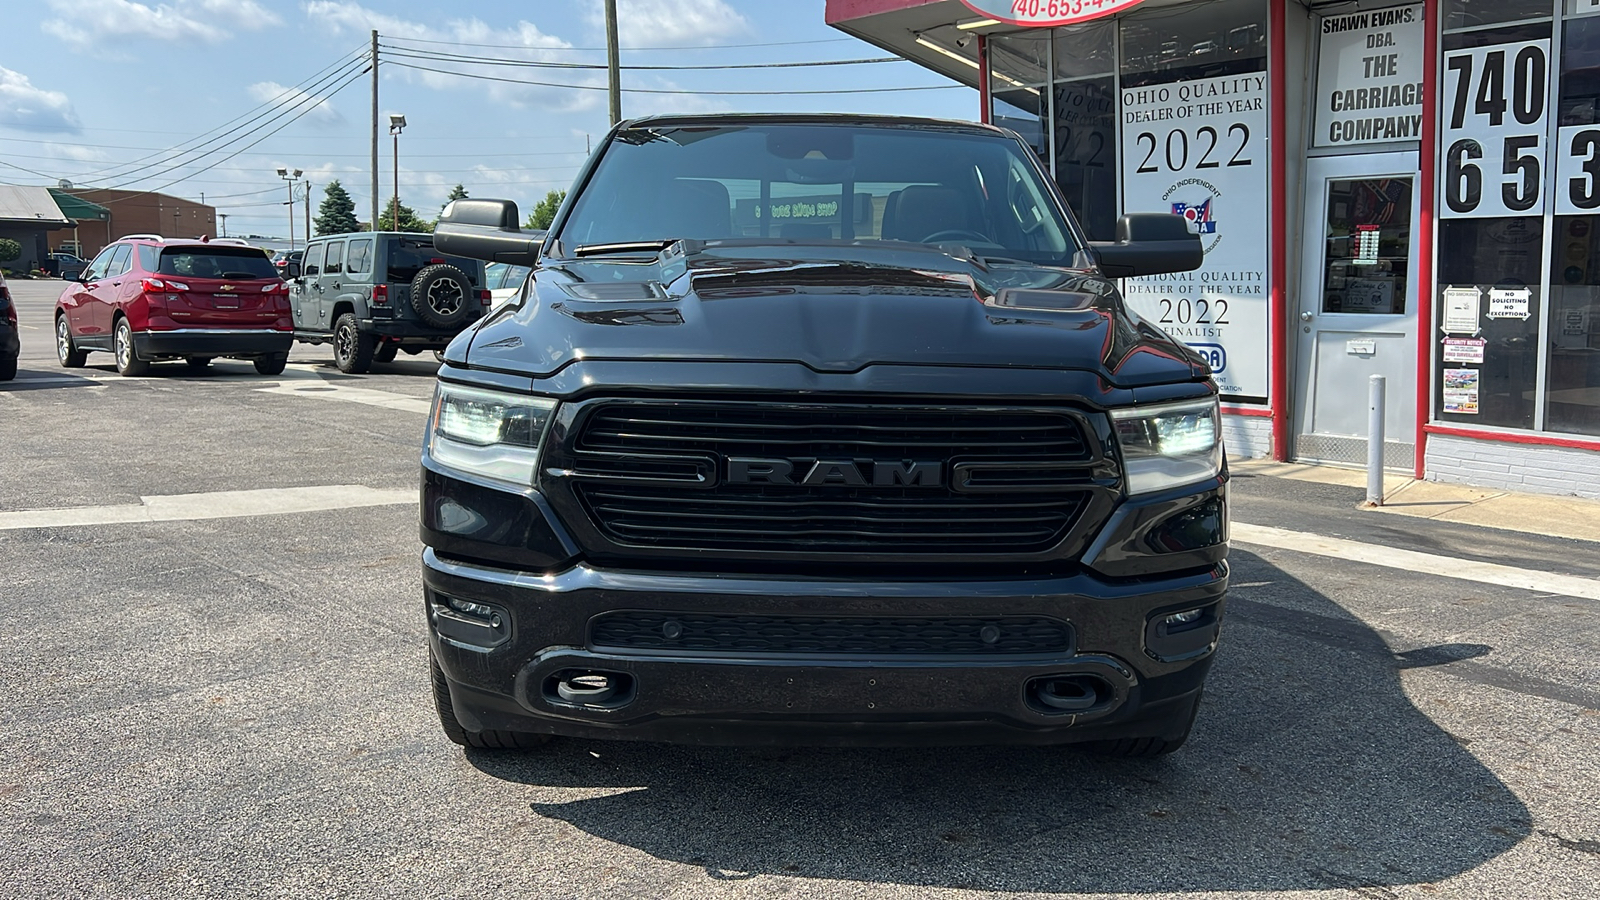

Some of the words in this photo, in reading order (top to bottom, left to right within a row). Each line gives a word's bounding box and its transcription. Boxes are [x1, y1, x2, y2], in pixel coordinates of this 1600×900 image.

[1323, 13, 1368, 34] SHAWN
[1371, 7, 1415, 27] EVANS.
[1366, 32, 1396, 49] DBA.
[1362, 53, 1398, 79] THE
[1123, 88, 1170, 106] OHIO
[1178, 76, 1265, 102] QUALITY
[1330, 82, 1424, 113] CARRIAGE
[1448, 45, 1545, 130] 740
[1126, 107, 1173, 124] DEALER
[1177, 105, 1194, 119] OF
[1196, 102, 1223, 116] THE
[1226, 97, 1263, 113] YEAR
[1329, 114, 1423, 143] COMPANY
[1136, 122, 1252, 174] 2022
[1162, 184, 1177, 201] OHIO
[1177, 178, 1222, 198] INDEPENDENT
[1129, 285, 1173, 294] DEALER
[1179, 285, 1194, 294] OF
[1199, 285, 1223, 294] THE
[1228, 285, 1261, 294] YEAR
[1201, 271, 1263, 283] QUALITY
[1159, 298, 1229, 325] 2022
[727, 456, 943, 486] RAM
